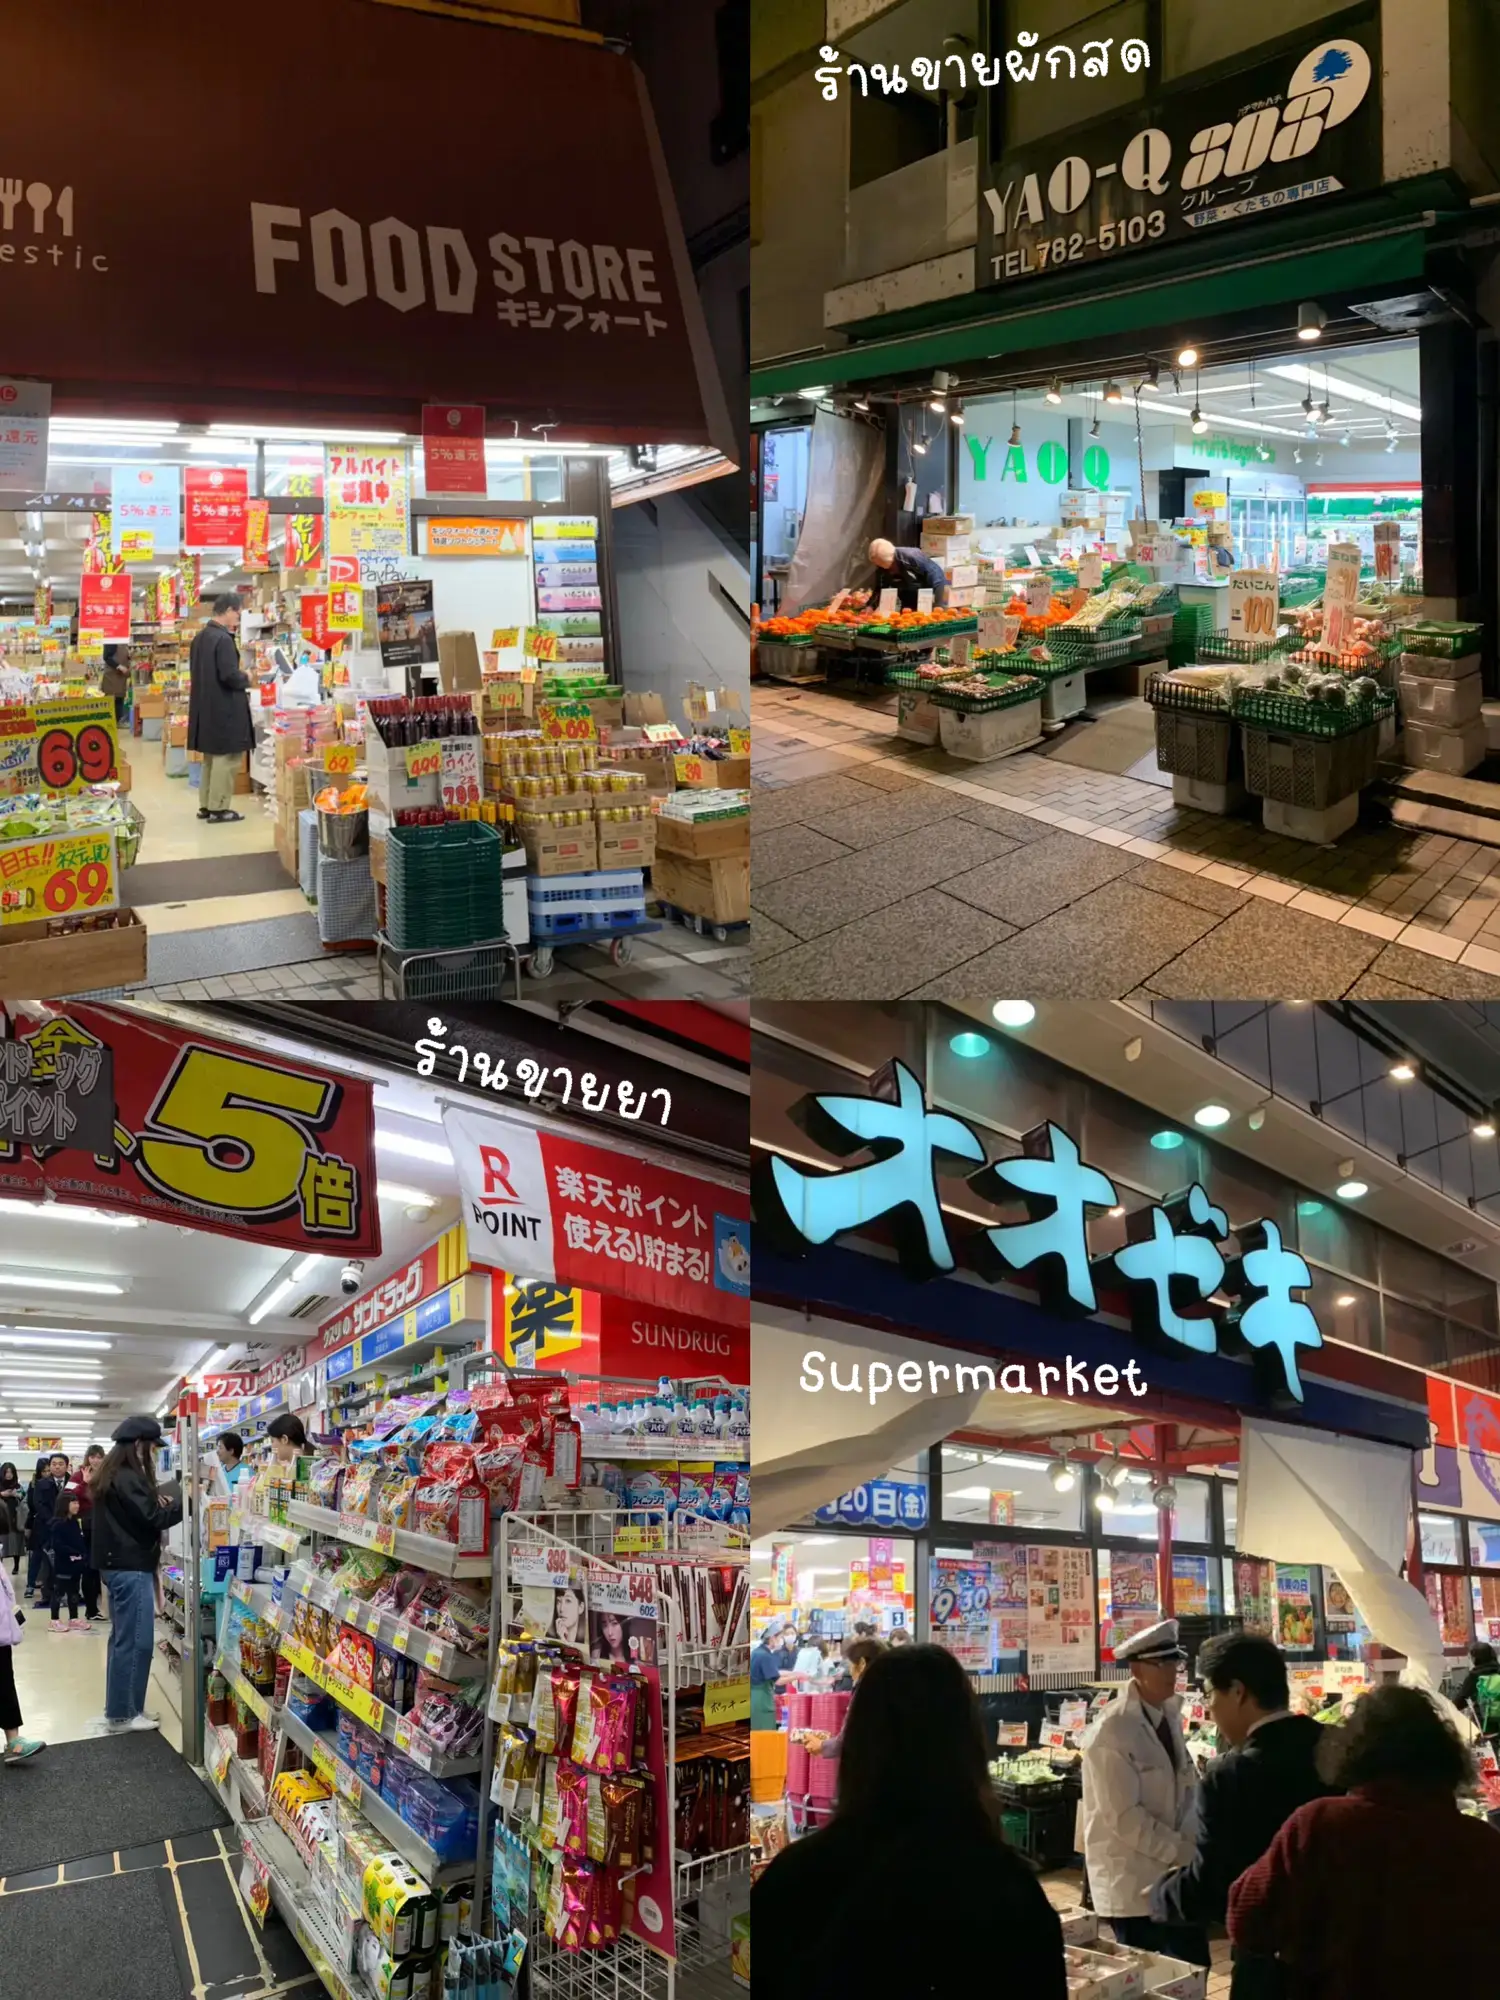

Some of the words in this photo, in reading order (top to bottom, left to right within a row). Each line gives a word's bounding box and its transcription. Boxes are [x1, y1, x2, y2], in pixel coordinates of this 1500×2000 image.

[983, 128, 1172, 235] YAO-Q
[1180, 175, 1258, 211] グループ
[1193, 180, 1330, 226] 野菜・くだもの専門店
[251, 202, 478, 314] FOOD
[489, 232, 662, 303] STORE
[991, 249, 1035, 281] TEL
[1036, 209, 1167, 268] 782-5103
[498, 300, 668, 337] キシフォート
[329, 456, 400, 475] アルバイト
[192, 504, 242, 517] 5%還元
[359, 563, 408, 583] PayPay
[1232, 578, 1275, 591] だいこん
[37, 724, 115, 789] 69
[43, 862, 109, 912] 69
[554, 1165, 708, 1237] 楽天ポイント
[472, 1203, 541, 1241] POINT
[563, 1212, 710, 1284] 使える!貯まる!
[631, 1321, 731, 1356] SUNDRUG
[212, 1376, 259, 1398] クスリ
[826, 1485, 926, 1519] 20日(金)
[546, 1549, 567, 1573] 398
[629, 1575, 653, 1603] 548
[640, 1604, 655, 1617] 602
